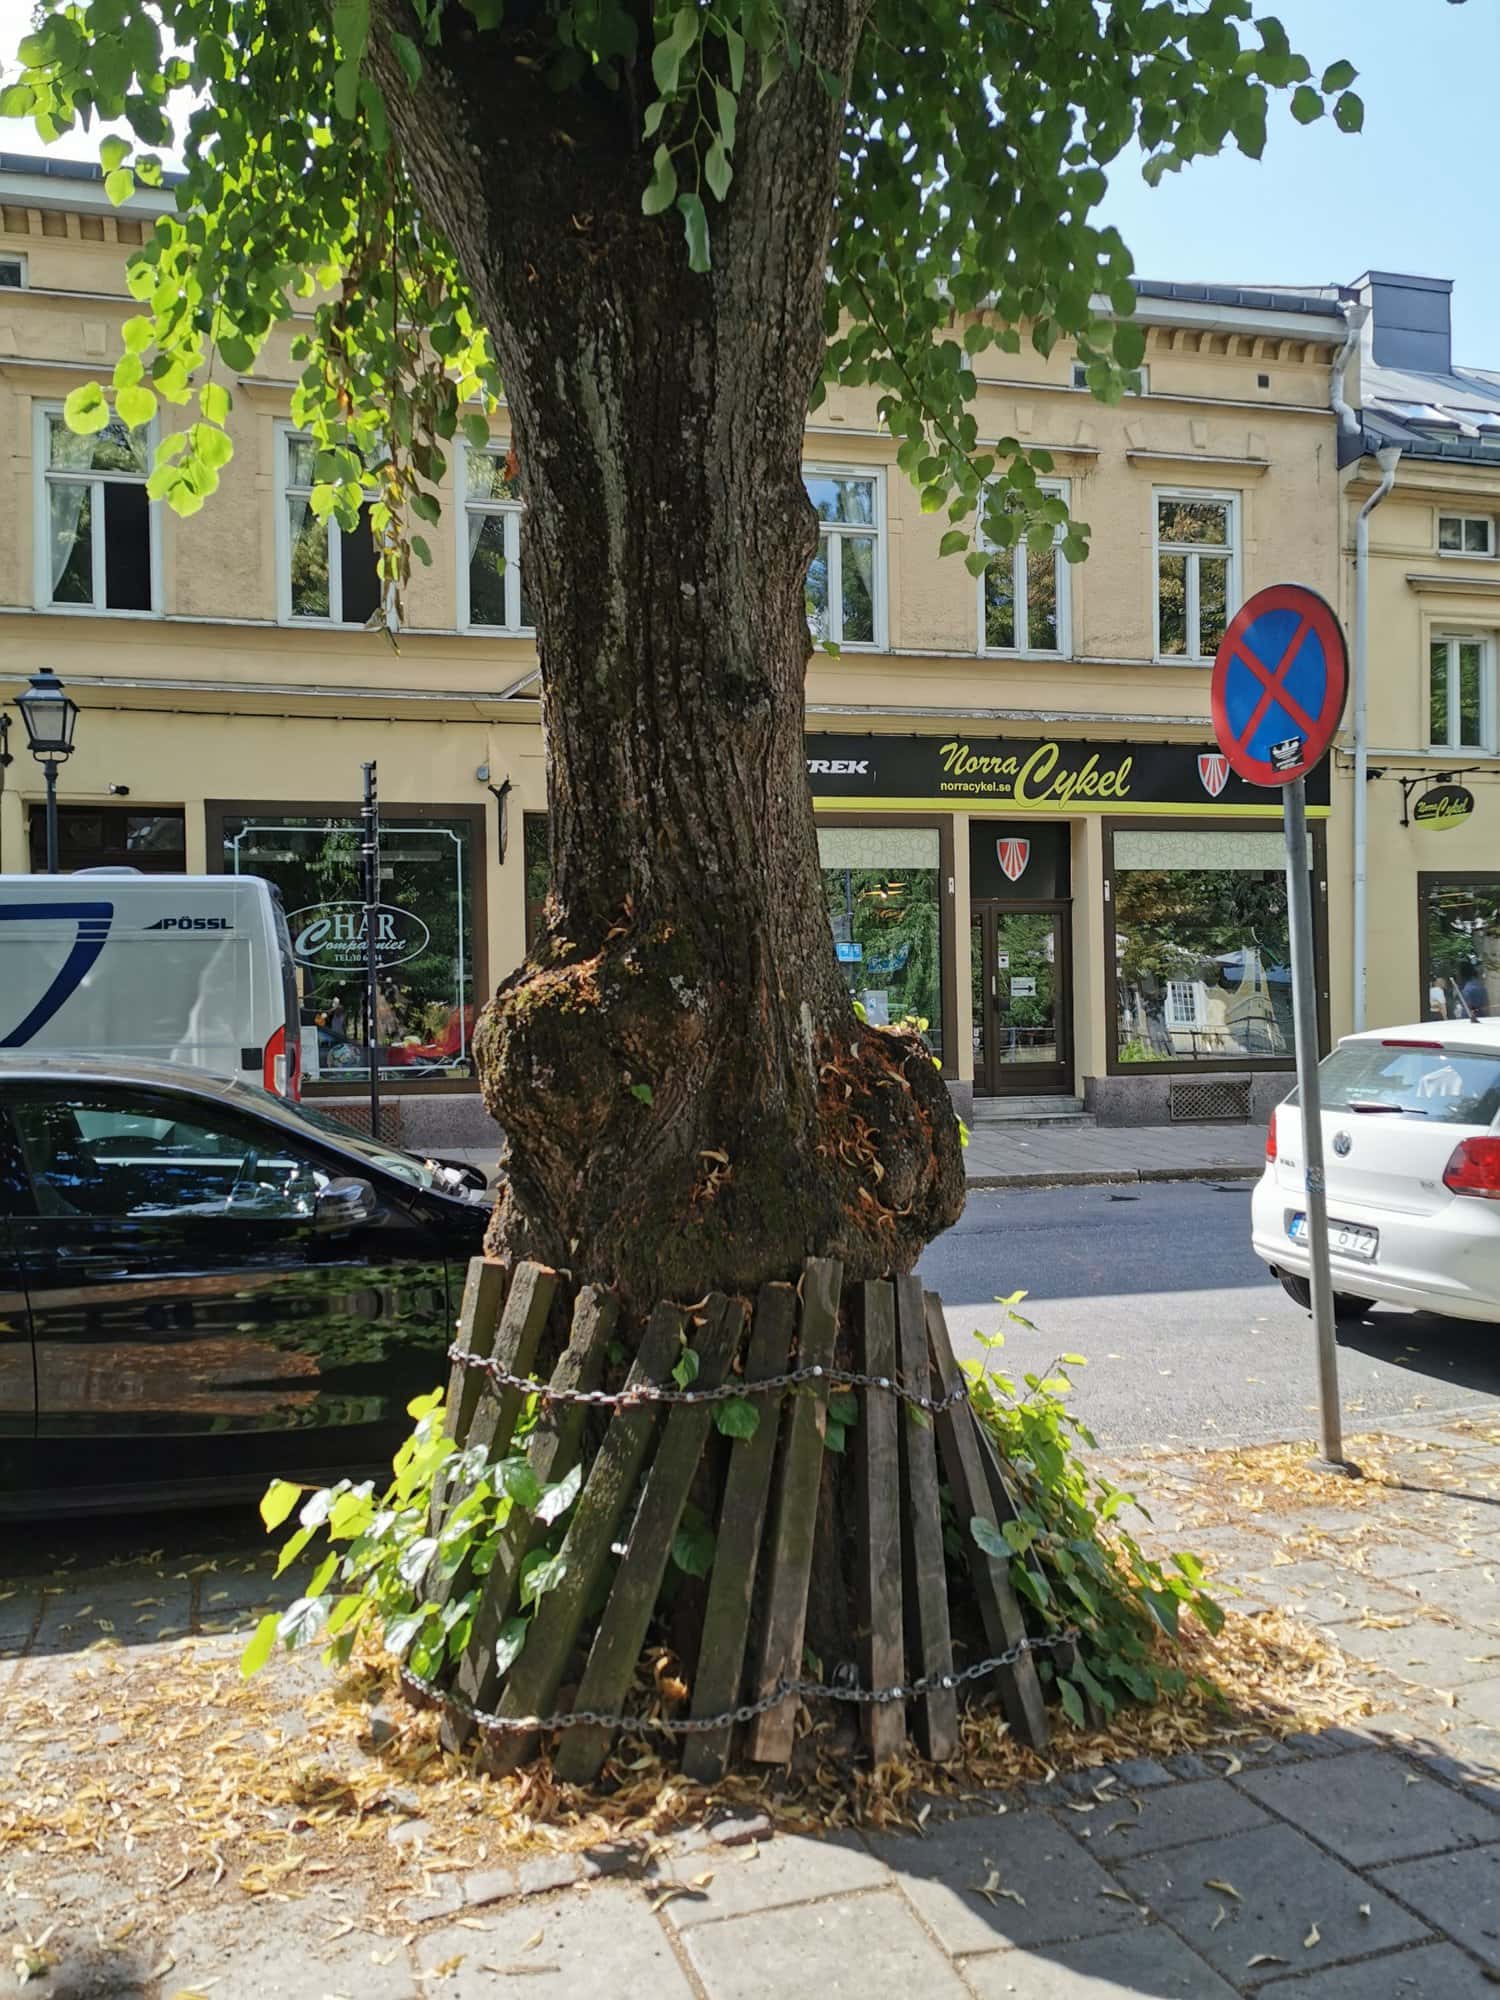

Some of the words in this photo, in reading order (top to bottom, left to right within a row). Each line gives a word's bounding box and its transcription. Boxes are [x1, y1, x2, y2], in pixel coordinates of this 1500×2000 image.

[807, 759, 869, 774] REK
[939, 742, 1020, 776] Norra
[1014, 742, 1133, 809] Cykel
[940, 781, 1011, 794] norracykel.se
[163, 915, 234, 930] PÖSSL
